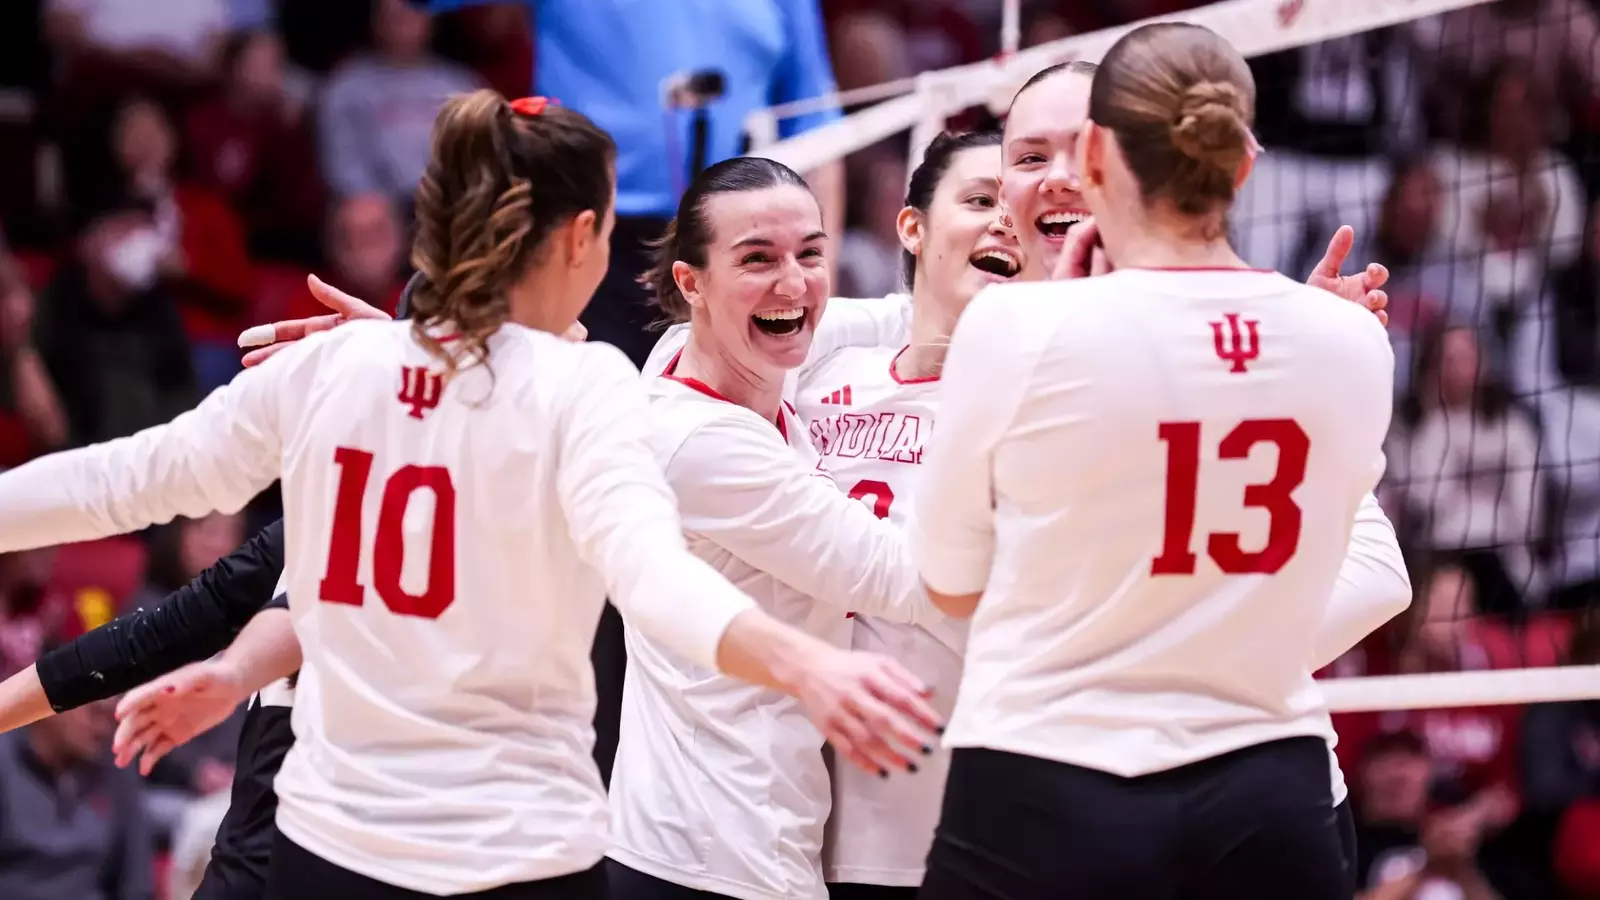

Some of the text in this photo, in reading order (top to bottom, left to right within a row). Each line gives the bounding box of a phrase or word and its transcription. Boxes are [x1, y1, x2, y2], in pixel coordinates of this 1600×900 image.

[809, 412, 934, 472] NDIA
[1149, 417, 1311, 576] 13
[318, 446, 456, 619] 10
